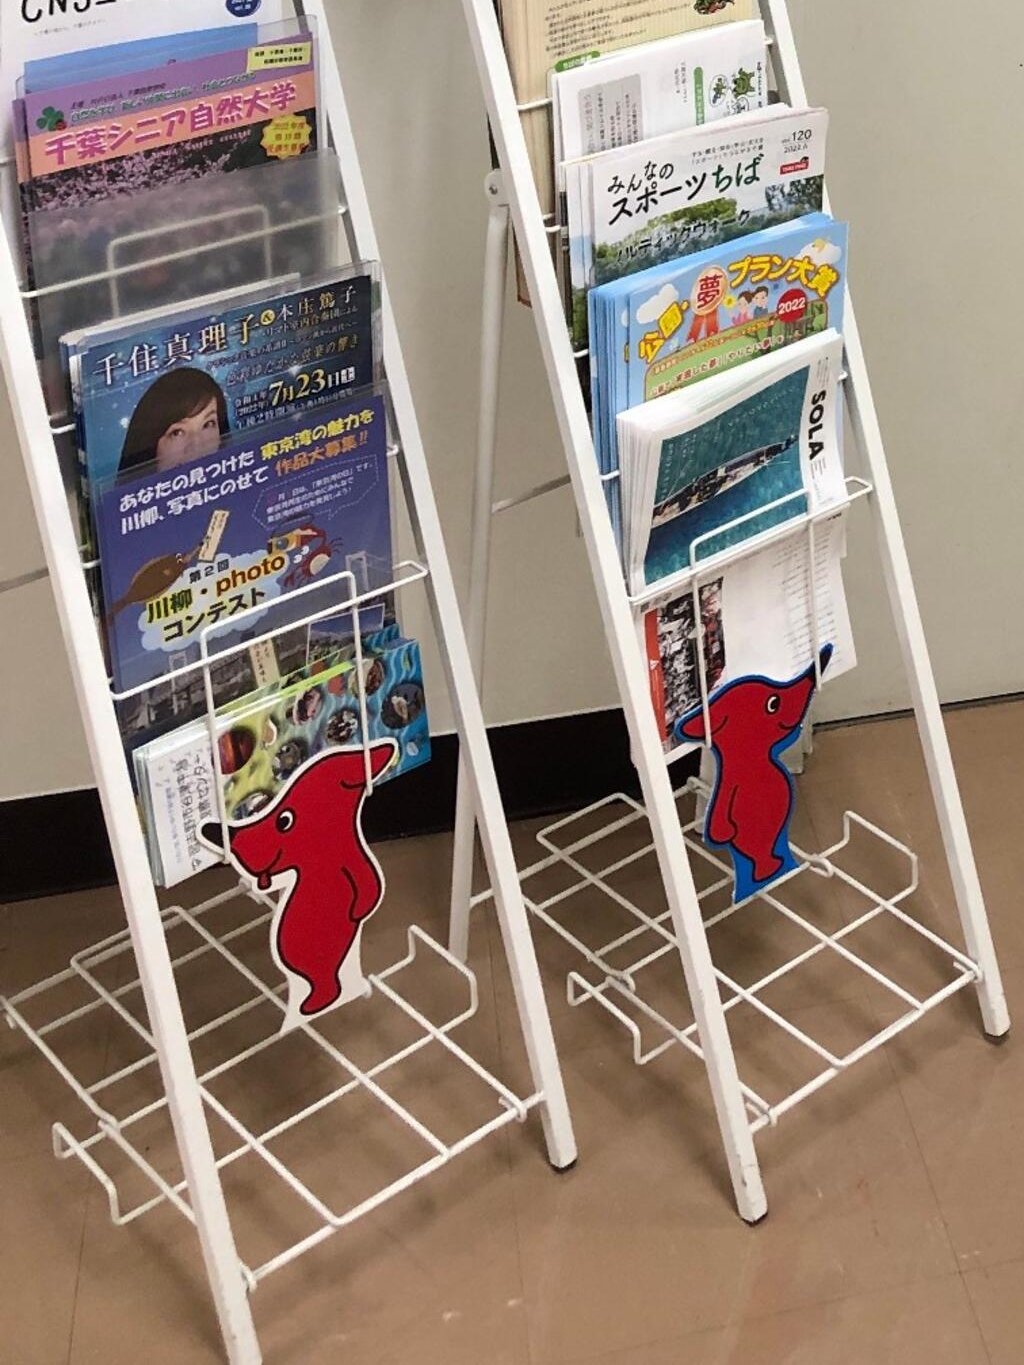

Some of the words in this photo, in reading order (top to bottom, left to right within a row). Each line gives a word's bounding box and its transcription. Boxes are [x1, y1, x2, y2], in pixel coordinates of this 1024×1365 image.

[45, 81, 297, 165] 千葉シニア自然大学
[792, 129, 813, 142] 120
[607, 160, 675, 194] みんなの
[609, 153, 764, 225] スポーツちば
[778, 299, 806, 315] 2022
[808, 389, 827, 462] SOLA
[119, 451, 255, 513] あなたの見つけた
[260, 409, 375, 462] 東京湾の魅力を
[121, 466, 269, 535] 川柳、写真にのせて
[163, 588, 266, 642] コンテスト
